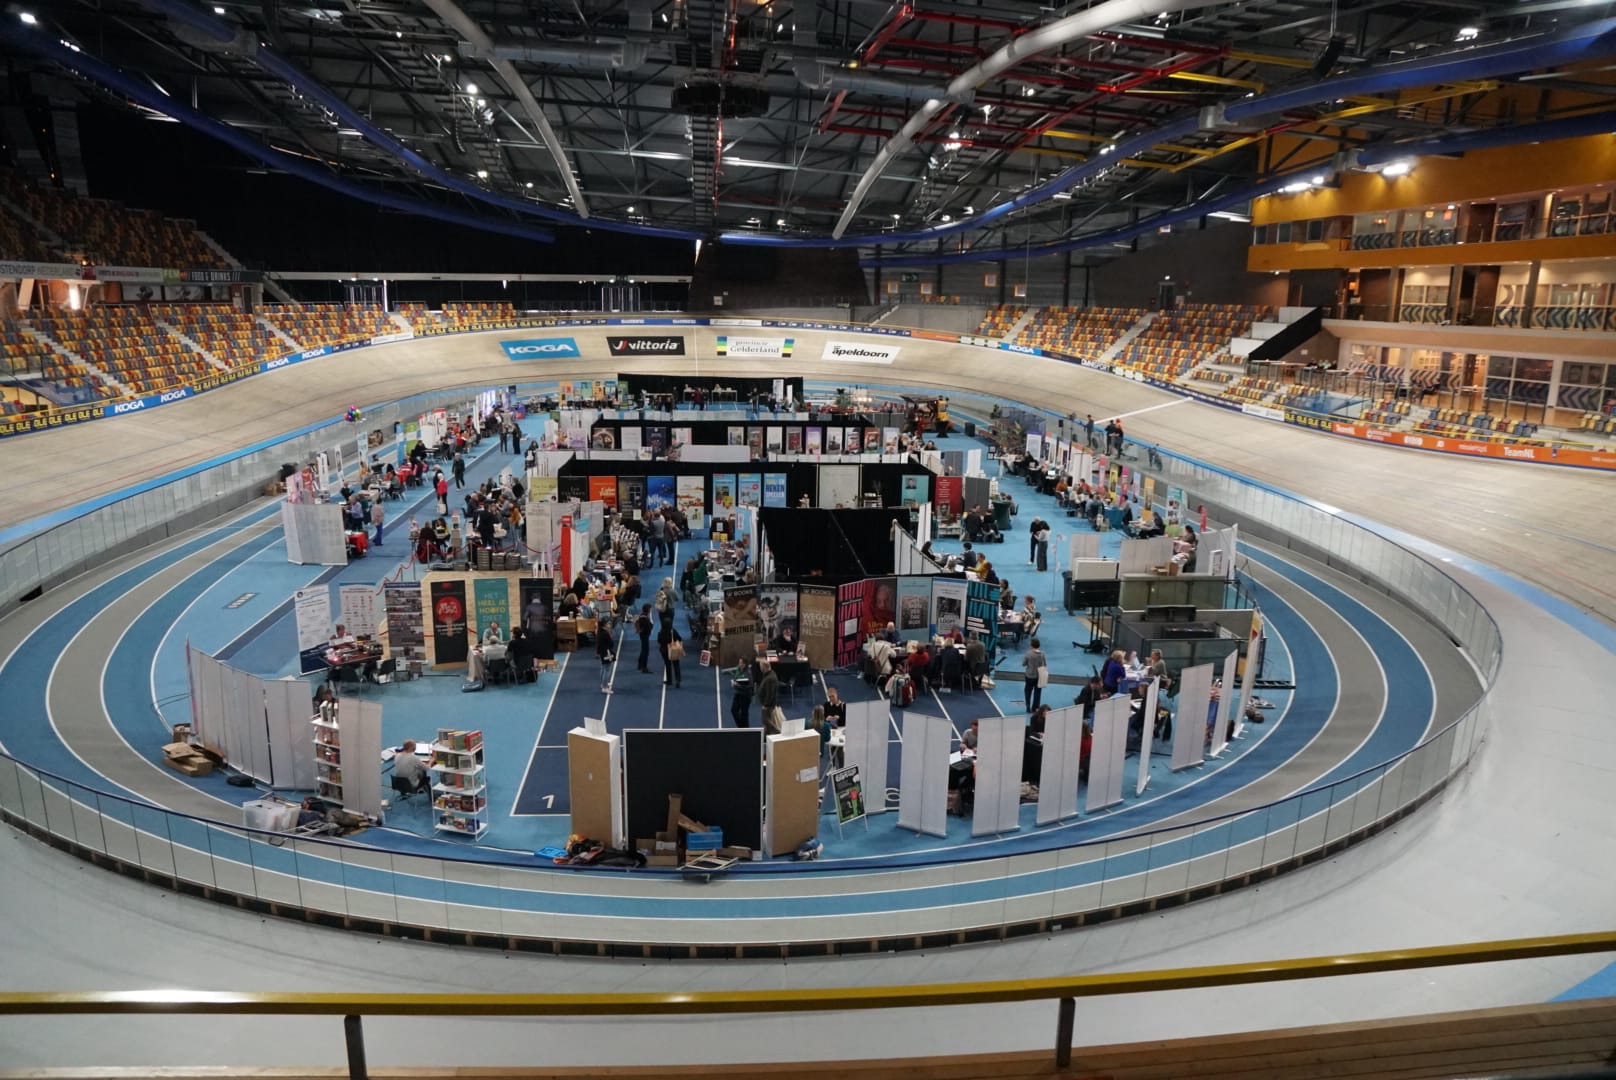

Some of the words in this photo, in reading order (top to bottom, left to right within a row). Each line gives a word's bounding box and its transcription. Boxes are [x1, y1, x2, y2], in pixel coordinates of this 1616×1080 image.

[509, 344, 573, 355] KOGA
[628, 339, 679, 350] vittoria
[730, 346, 780, 354] Gelderland
[1009, 344, 1034, 354] KOGA
[832, 345, 889, 359] apeldoorn
[267, 357, 289, 369] KOGA
[302, 348, 325, 359] KOGA
[115, 400, 144, 413] KOGA
[161, 389, 186, 403] KOGA
[1504, 446, 1535, 459] TeamNL
[802, 620, 828, 628] ATLAS
[541, 794, 554, 808] 1
